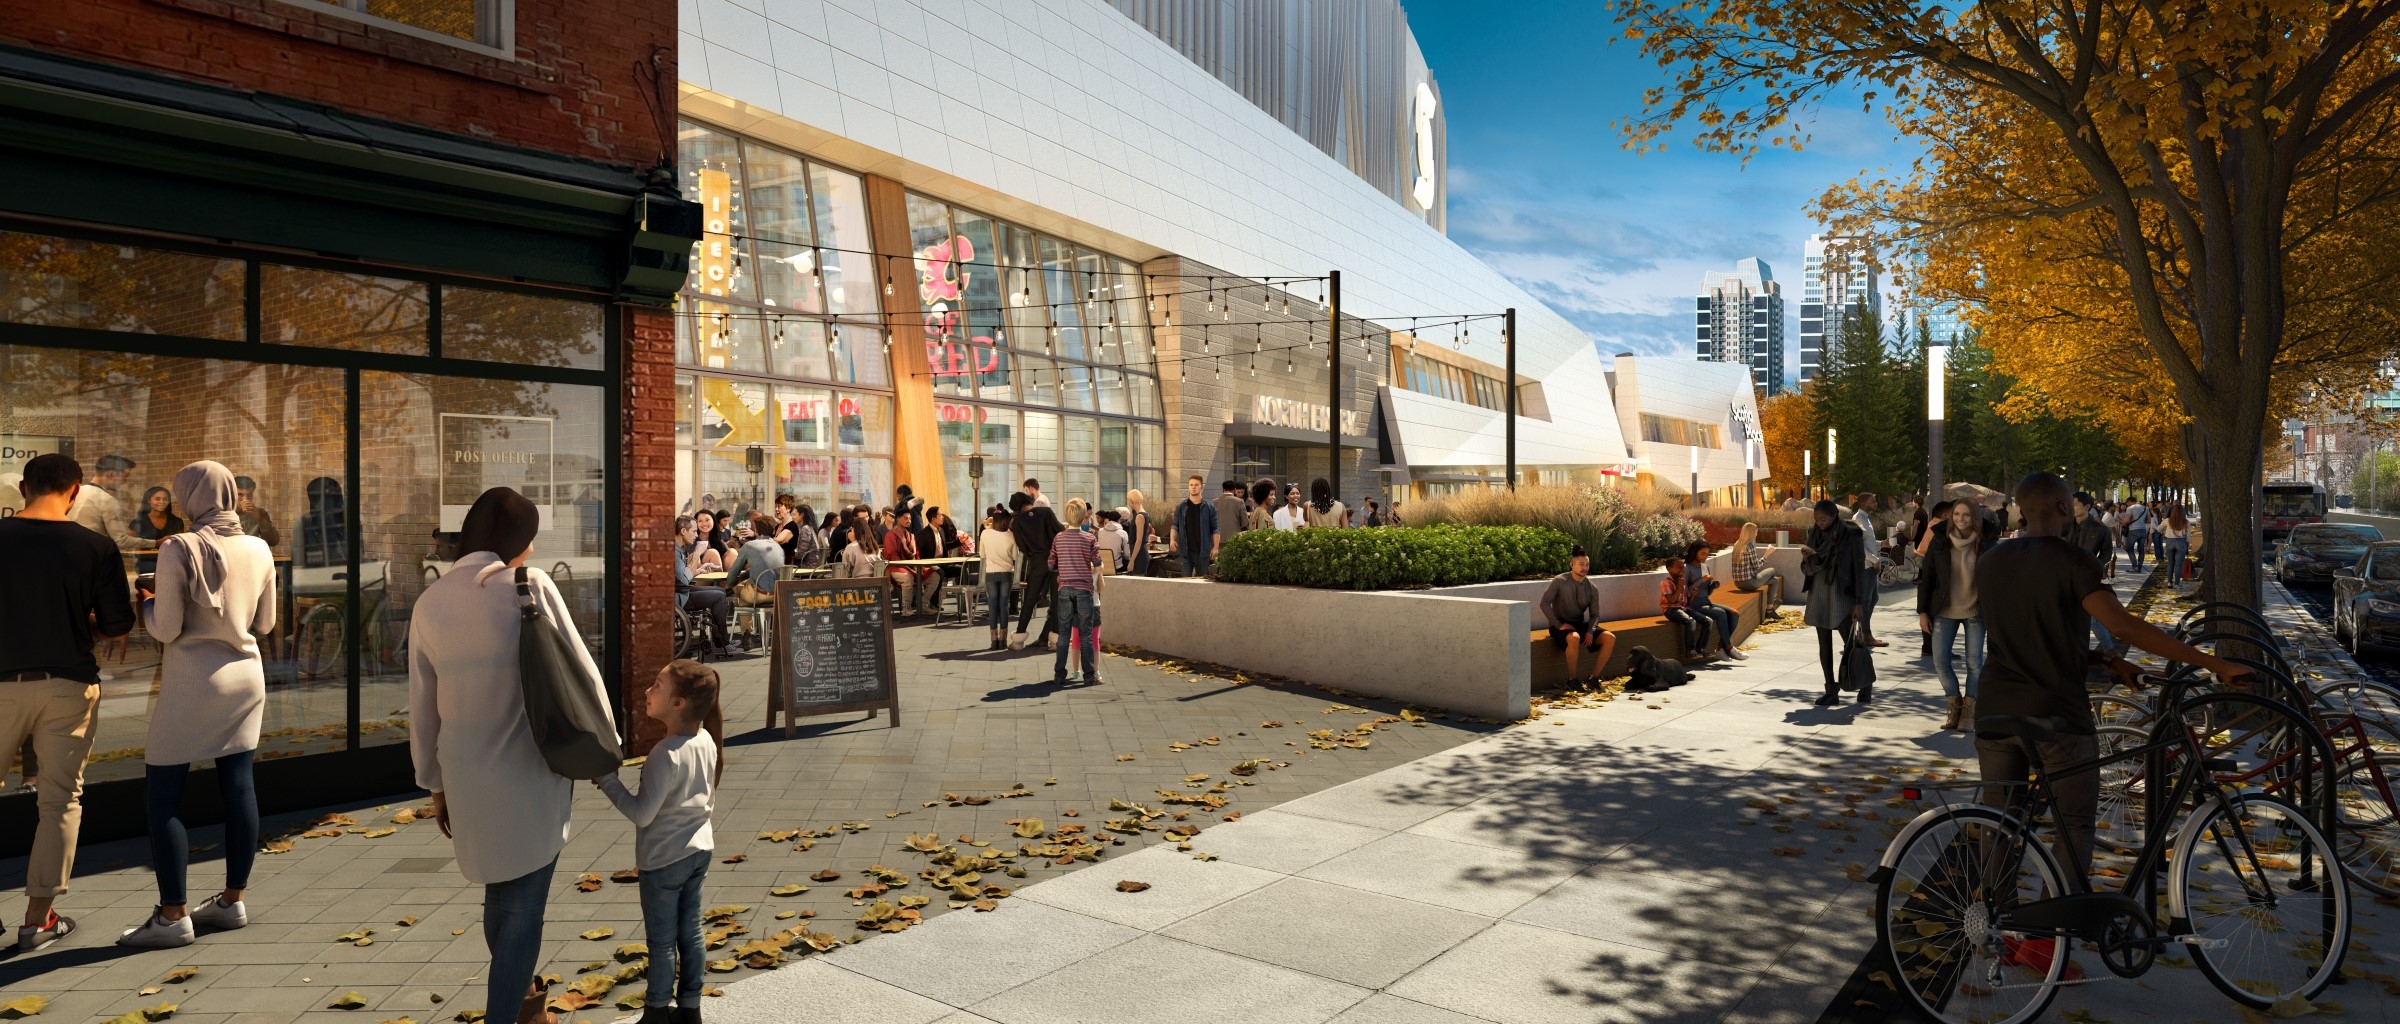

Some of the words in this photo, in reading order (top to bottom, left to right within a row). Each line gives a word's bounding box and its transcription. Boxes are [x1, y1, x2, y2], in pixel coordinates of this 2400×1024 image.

[934, 403, 988, 424] OO
[1252, 394, 1310, 430] NORTH
[1310, 404, 1357, 436] ENRY
[455, 450, 487, 463] POST
[492, 451, 536, 464] OFFICE
[797, 595, 832, 610] FOOD
[835, 591, 875, 607] HALL
